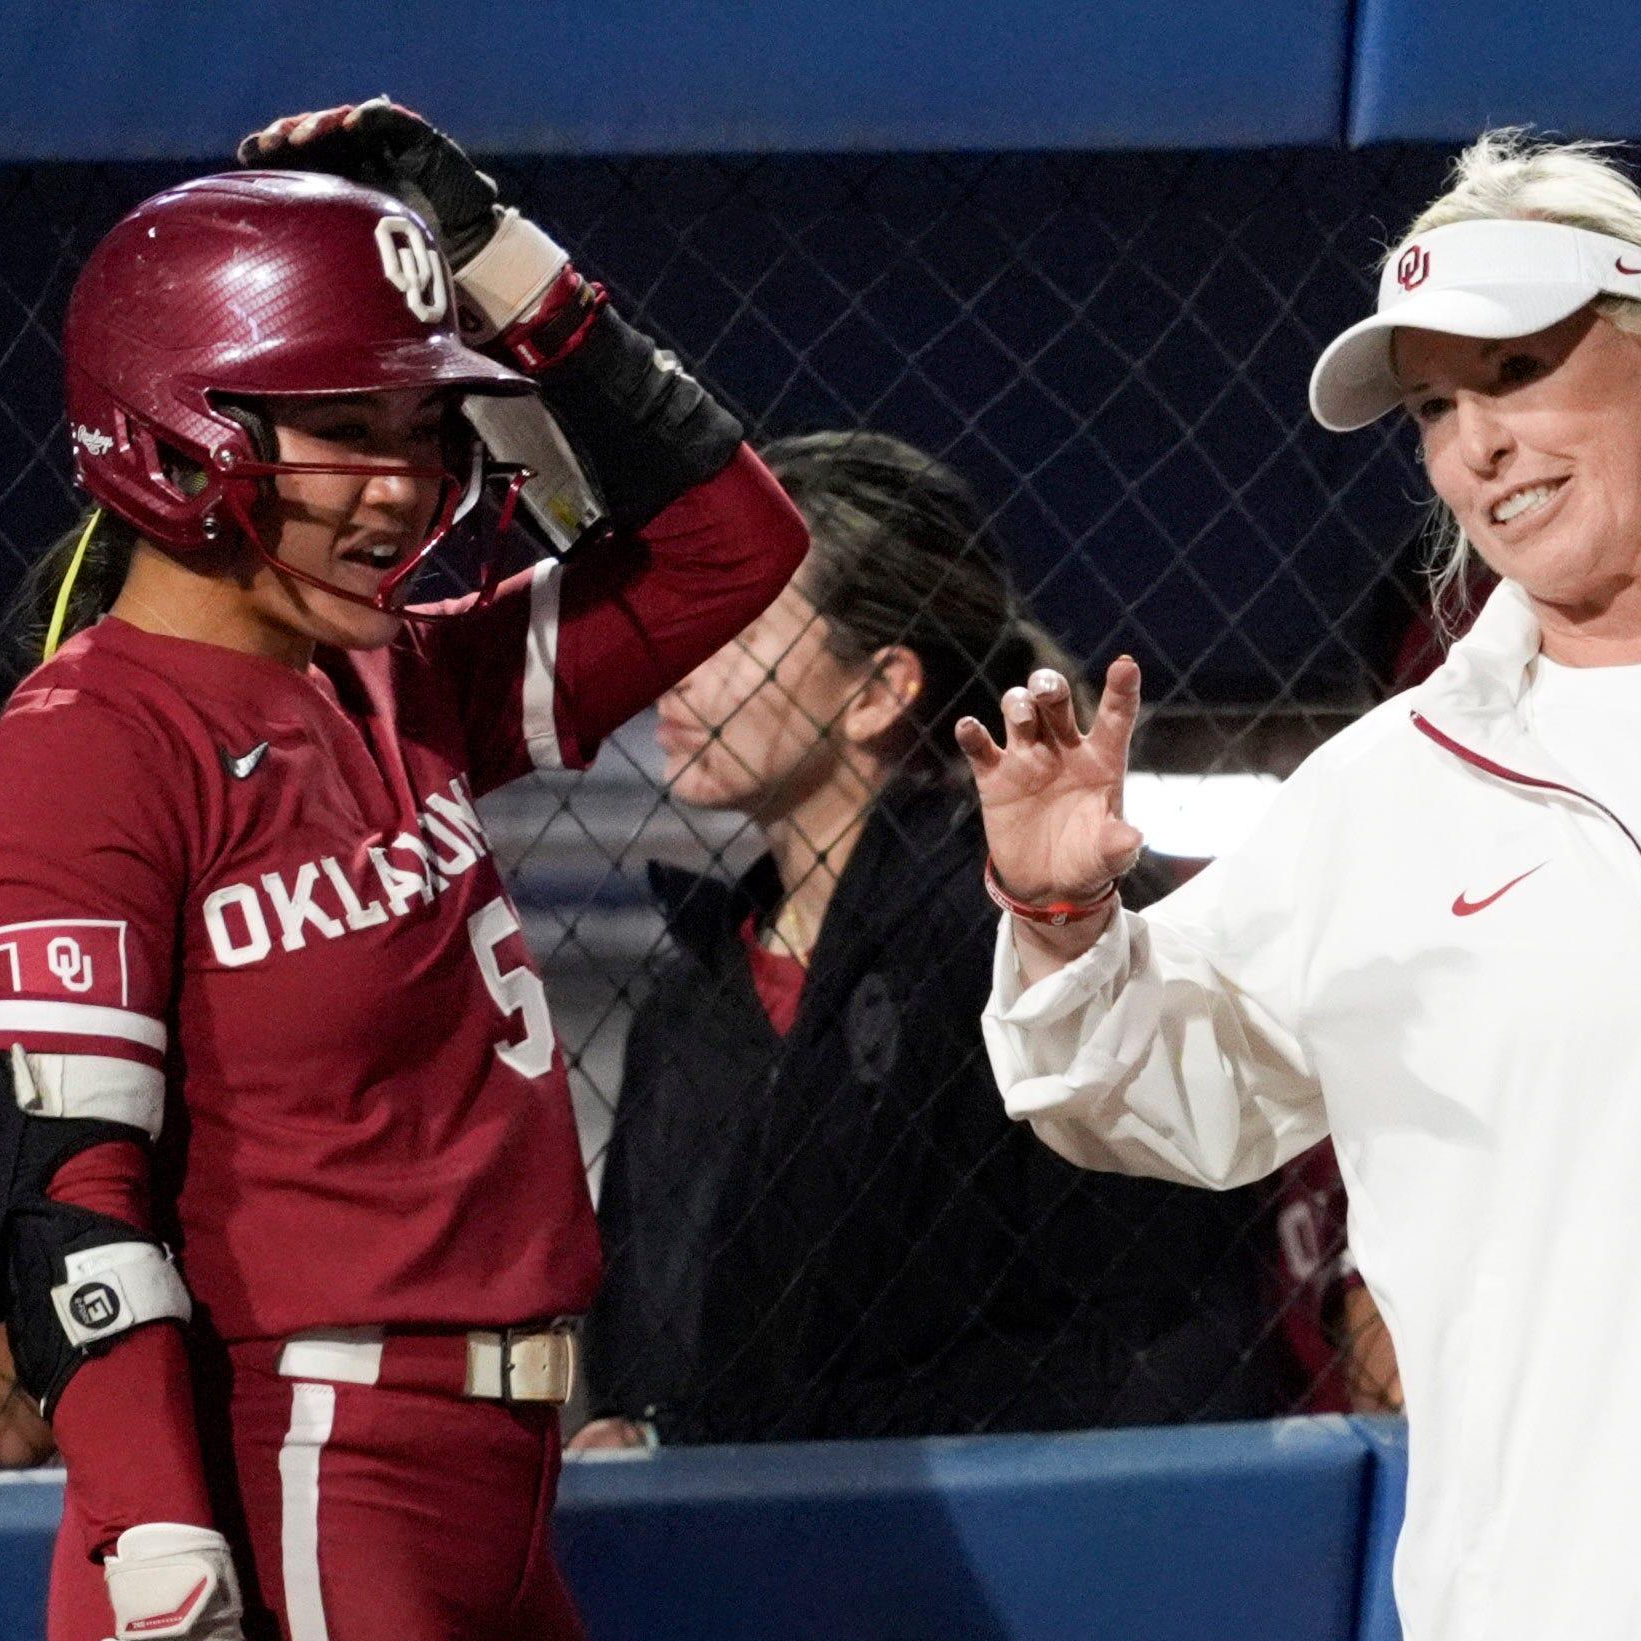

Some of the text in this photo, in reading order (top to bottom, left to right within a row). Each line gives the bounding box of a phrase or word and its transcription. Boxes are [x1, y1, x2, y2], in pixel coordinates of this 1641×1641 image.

[374, 215, 447, 323] OU
[1397, 245, 1431, 292] OU
[48, 937, 92, 992] OU
[466, 896, 556, 1079] 5
